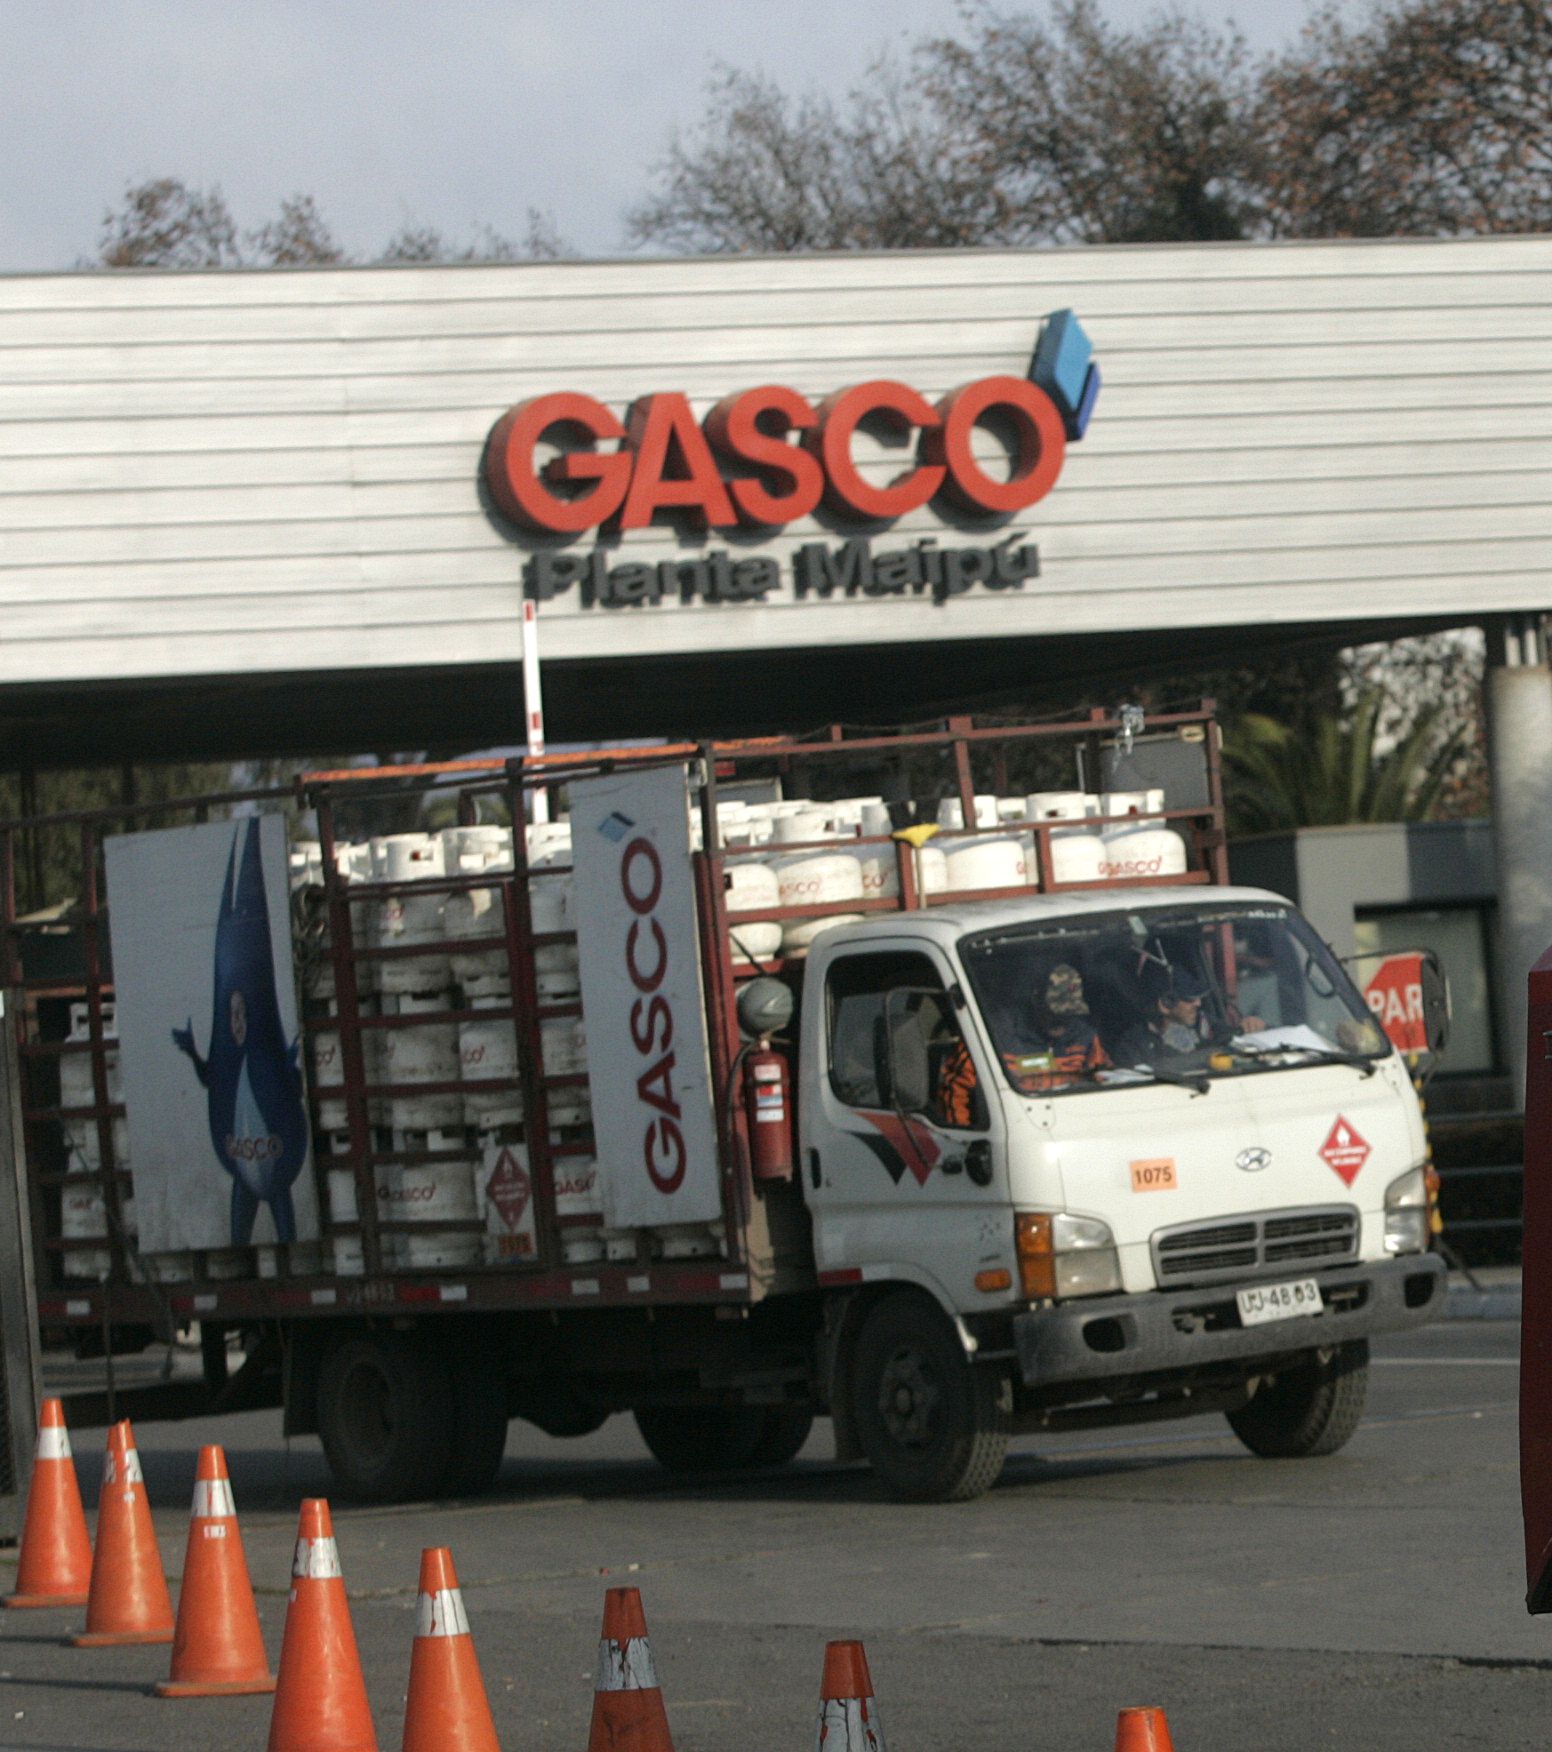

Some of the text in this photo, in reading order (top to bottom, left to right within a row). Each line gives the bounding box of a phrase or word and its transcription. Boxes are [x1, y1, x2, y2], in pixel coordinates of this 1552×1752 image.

[488, 375, 1067, 533] GASCO
[523, 532, 1041, 608] Planta Maipú
[621, 836, 687, 1195] GASCO
[1367, 983, 1424, 1026] PAR
[1134, 1165, 1173, 1185] 1075
